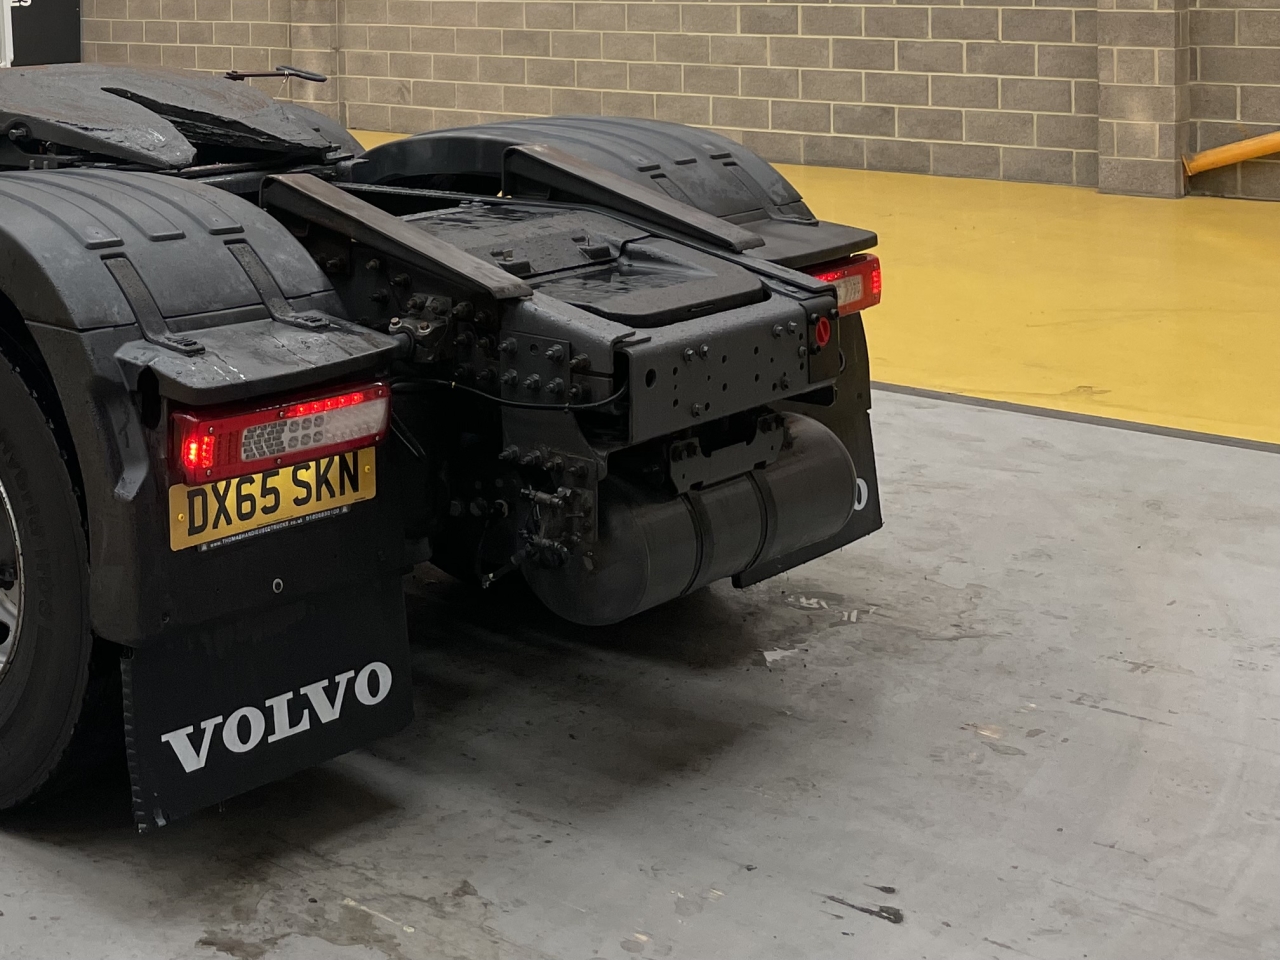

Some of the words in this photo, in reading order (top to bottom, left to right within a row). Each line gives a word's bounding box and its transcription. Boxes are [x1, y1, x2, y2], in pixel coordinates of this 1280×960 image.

[186, 469, 281, 537] DX65
[292, 451, 360, 507] SKN
[161, 661, 393, 773] VOLVO
